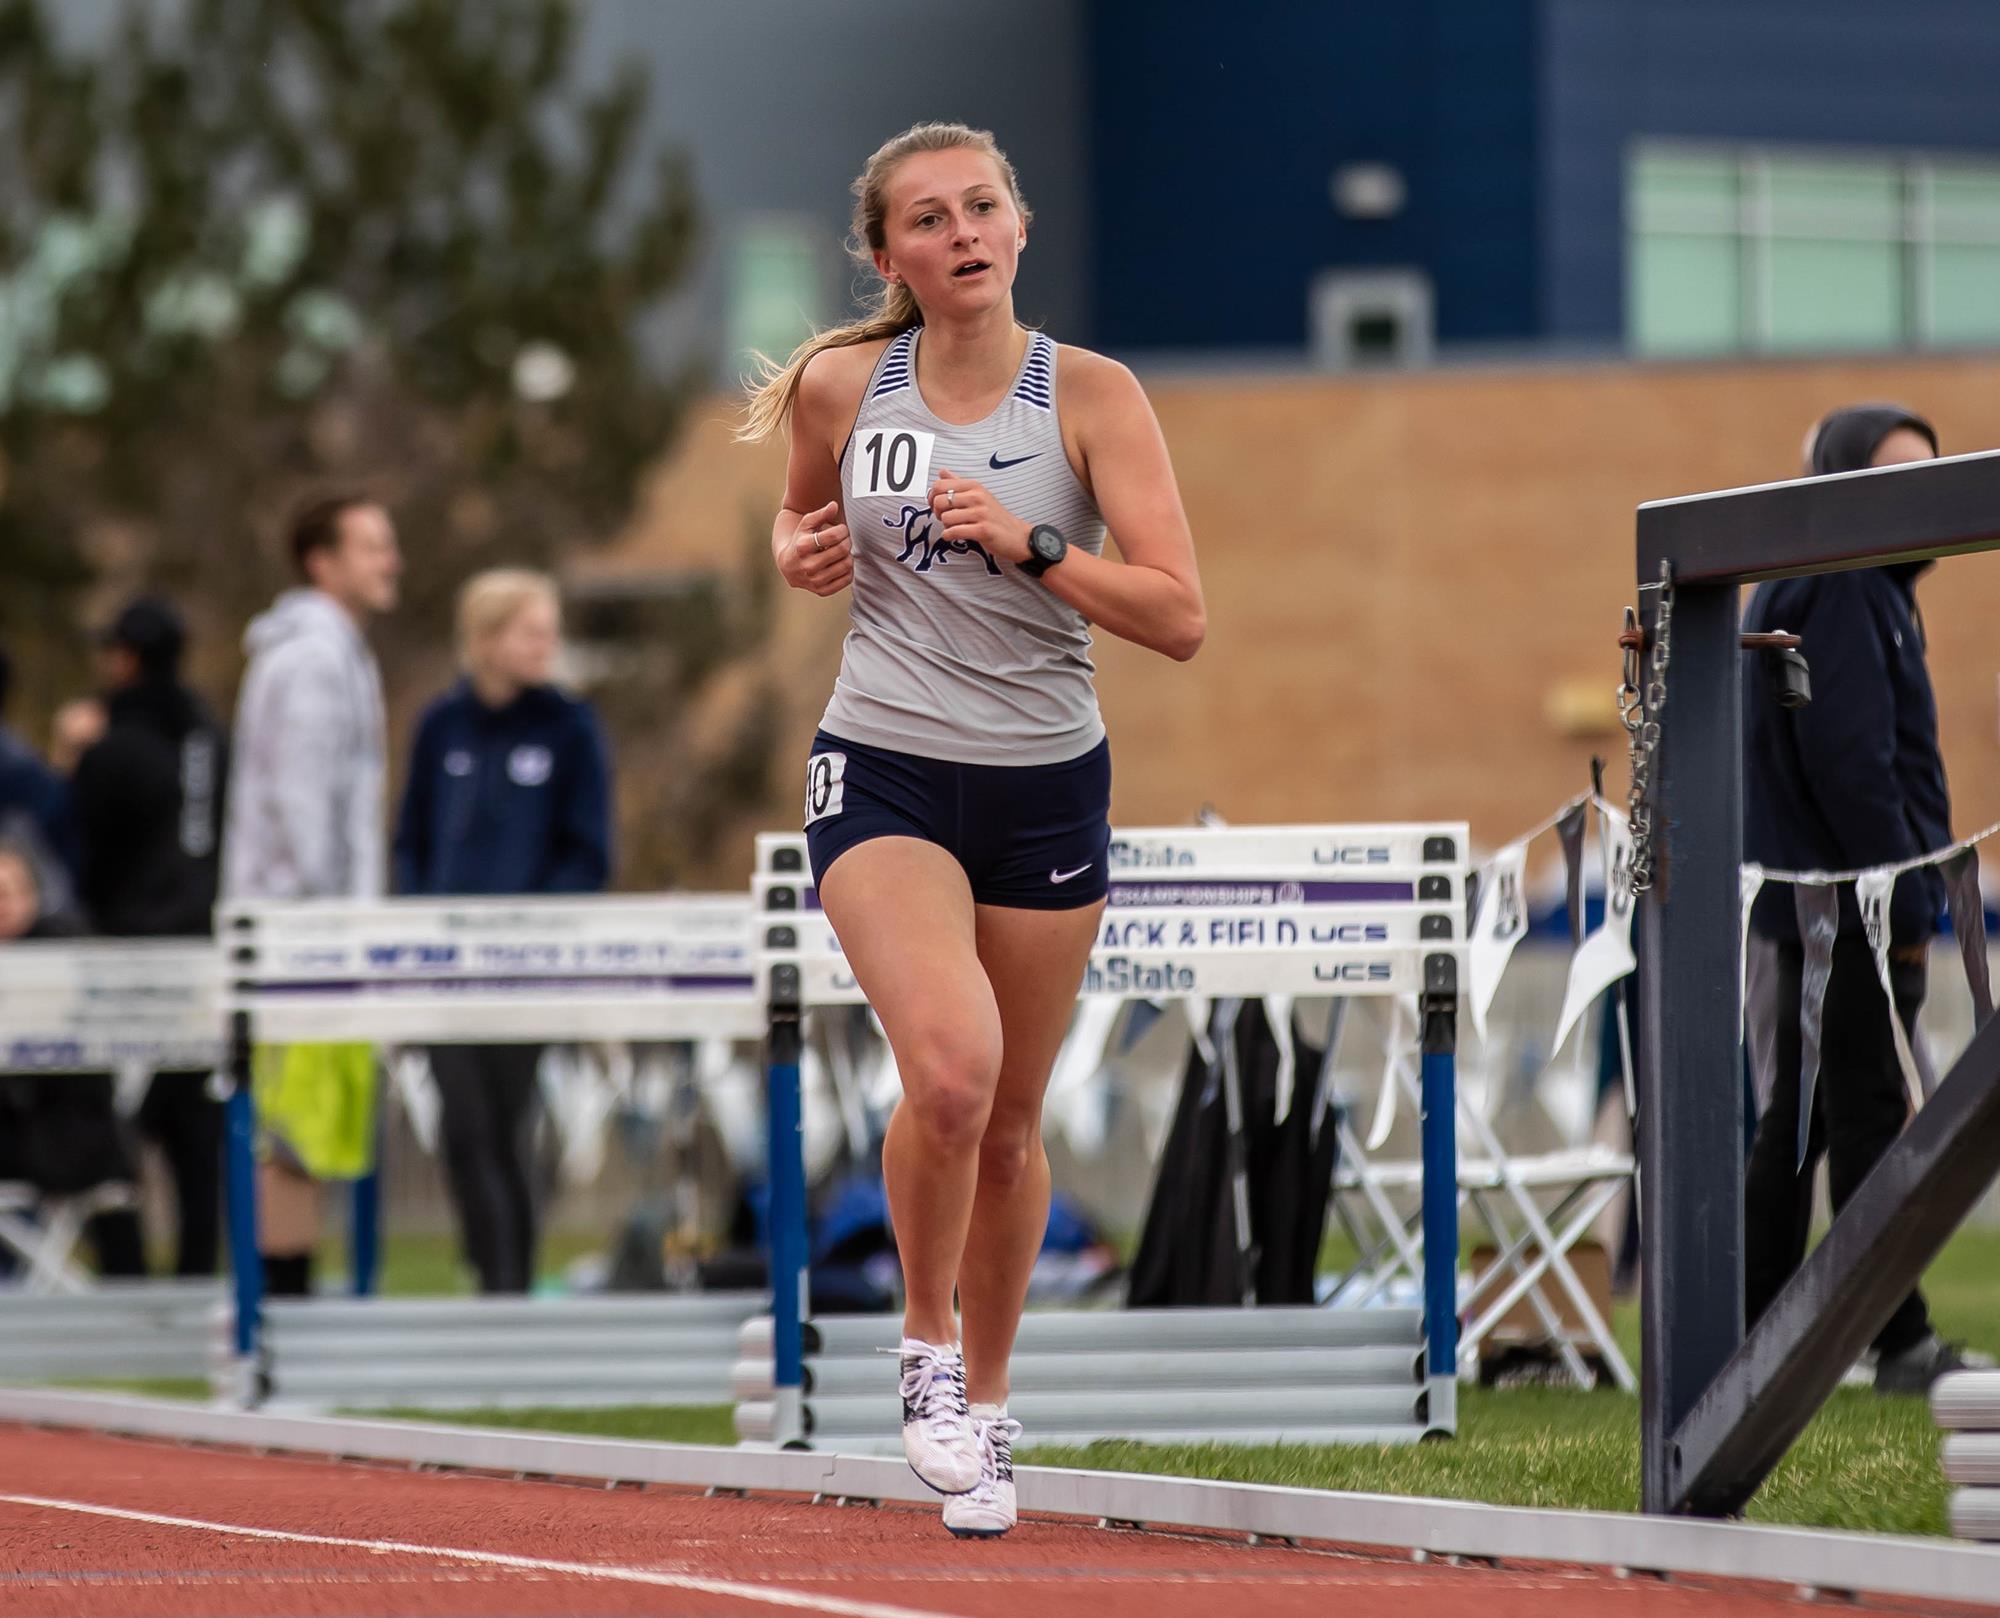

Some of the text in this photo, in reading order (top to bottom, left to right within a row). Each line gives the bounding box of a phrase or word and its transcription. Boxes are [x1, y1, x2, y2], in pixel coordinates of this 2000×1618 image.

[866, 432, 917, 493] 10
[1313, 846, 1390, 865] UCS
[1104, 919, 1165, 946] ACK
[1179, 920, 1198, 945] &
[1311, 924, 1388, 943] UCS
[1314, 961, 1391, 981] UCS
